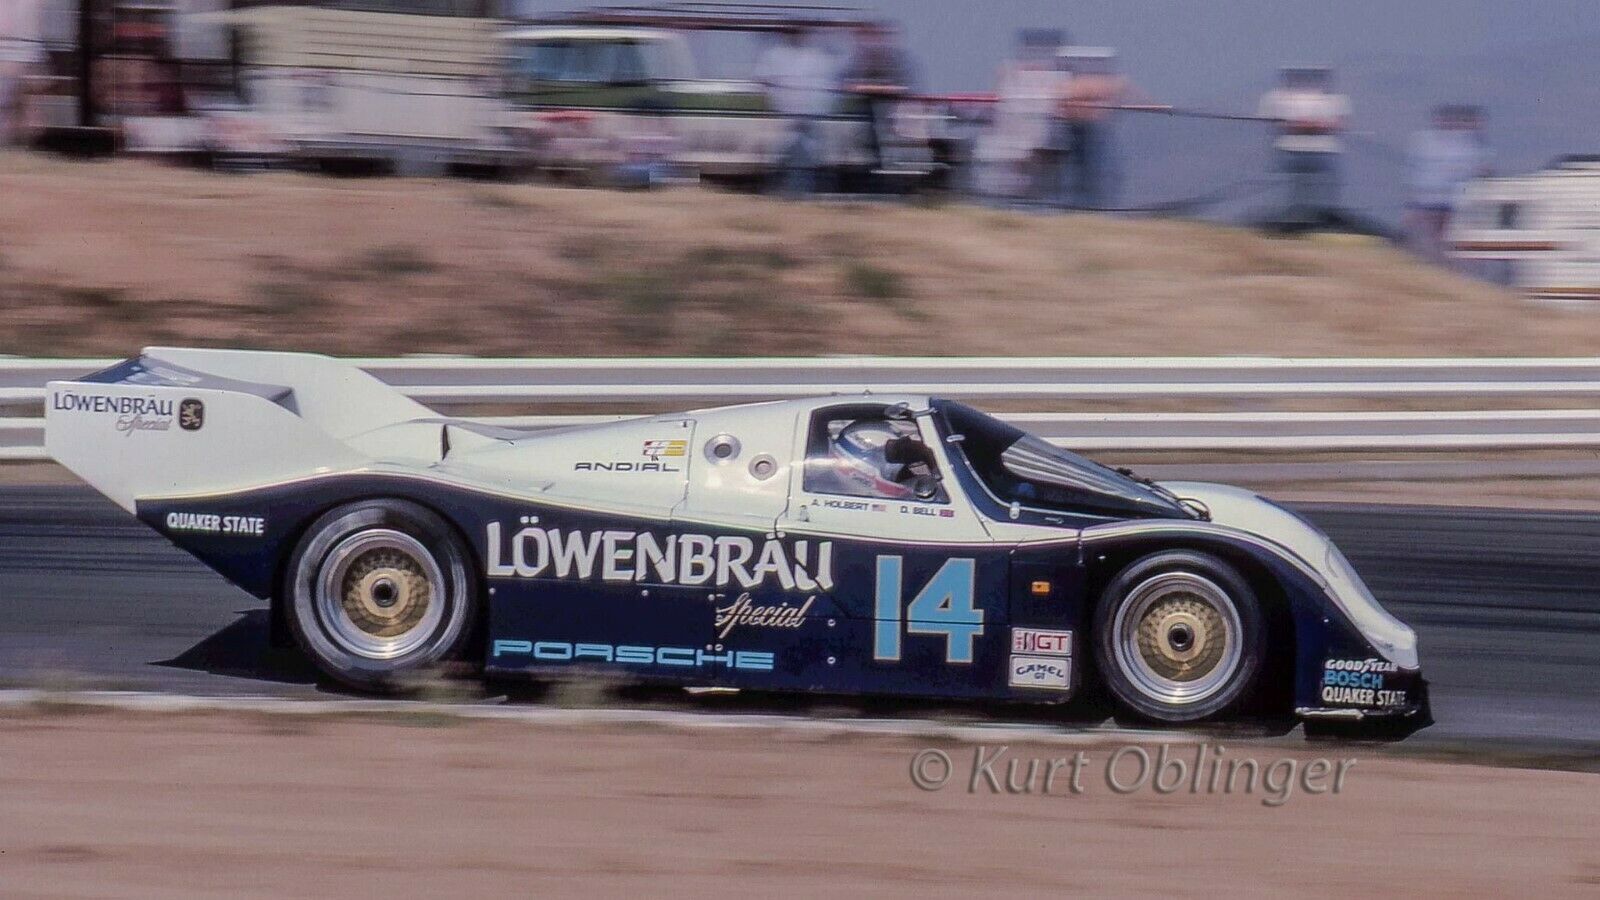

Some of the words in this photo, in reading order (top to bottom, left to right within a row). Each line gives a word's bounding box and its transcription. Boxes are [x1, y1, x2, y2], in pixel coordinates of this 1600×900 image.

[116, 414, 173, 437] Special
[575, 462, 680, 472] ANDIAL
[824, 500, 869, 511] HOLBERT
[913, 507, 937, 516] BELL
[166, 512, 221, 531] QUAKER
[222, 516, 265, 533] STATE
[487, 516, 834, 592] LÖWENBRÄU
[714, 592, 817, 639] Special
[874, 555, 985, 664] 14
[493, 639, 775, 671] PORSCHE
[1016, 664, 1064, 678] CAMEL
[1324, 670, 1384, 689] BOSCH
[1322, 686, 1374, 705] QUAKER
